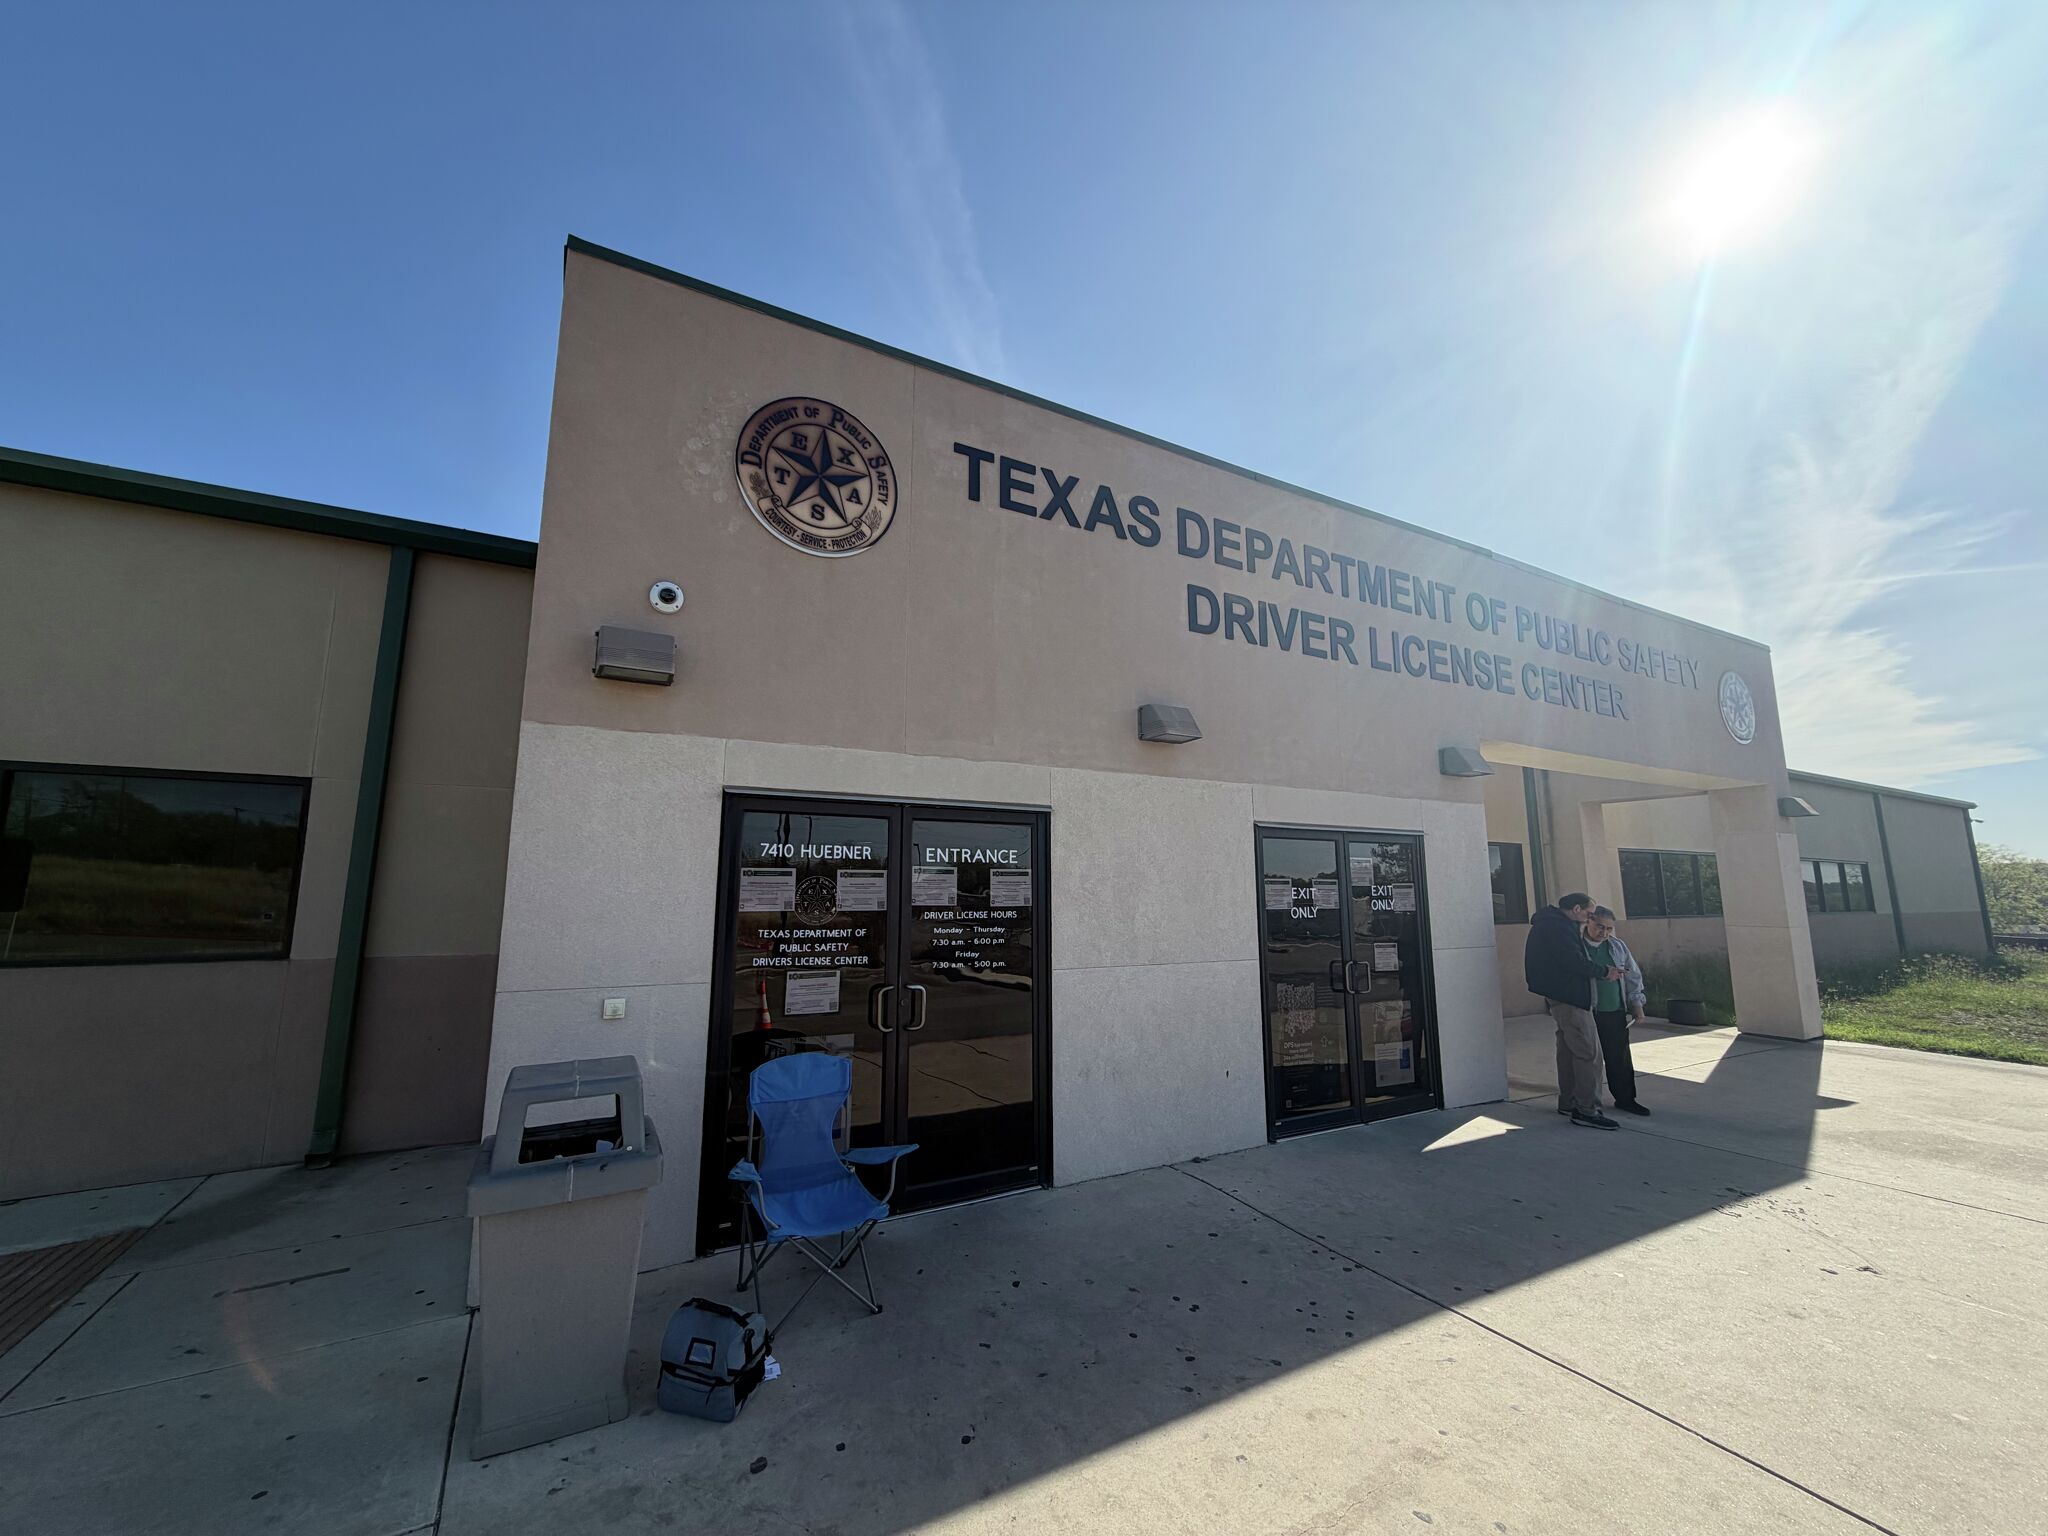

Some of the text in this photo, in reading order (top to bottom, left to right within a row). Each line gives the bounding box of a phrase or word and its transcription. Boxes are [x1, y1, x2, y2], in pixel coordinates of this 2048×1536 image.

[740, 406, 889, 507] DEPARTMENT OF PUBLIC SAFETY
[765, 507, 867, 549] COURTESY SERVICE PROTECTION
[953, 441, 1701, 690] TEXAS DEPARTMENT OF PUBLIC SAFETY
[1187, 583, 1631, 722] DRIVER LICENSE CENTER
[760, 843, 872, 860] 7410 HUEBNER
[926, 847, 1018, 864] ENTRANCE
[1292, 887, 1317, 899] EXIT
[1371, 885, 1392, 896] EXIT
[1371, 899, 1395, 910] ONLY
[924, 911, 953, 919] DRIVER
[956, 911, 988, 919] LICENSE
[1291, 906, 1318, 919] ONLY
[758, 929, 866, 938] TEXAS DEPARTMENT OF
[933, 927, 964, 935] Monday
[973, 926, 1005, 934] Thursday
[779, 943, 849, 952] PUBLIC SAFETY
[955, 951, 980, 959] Friday
[753, 956, 868, 966] DRIVERS LICENSE CENTER
[932, 961, 949, 969] 7:30
